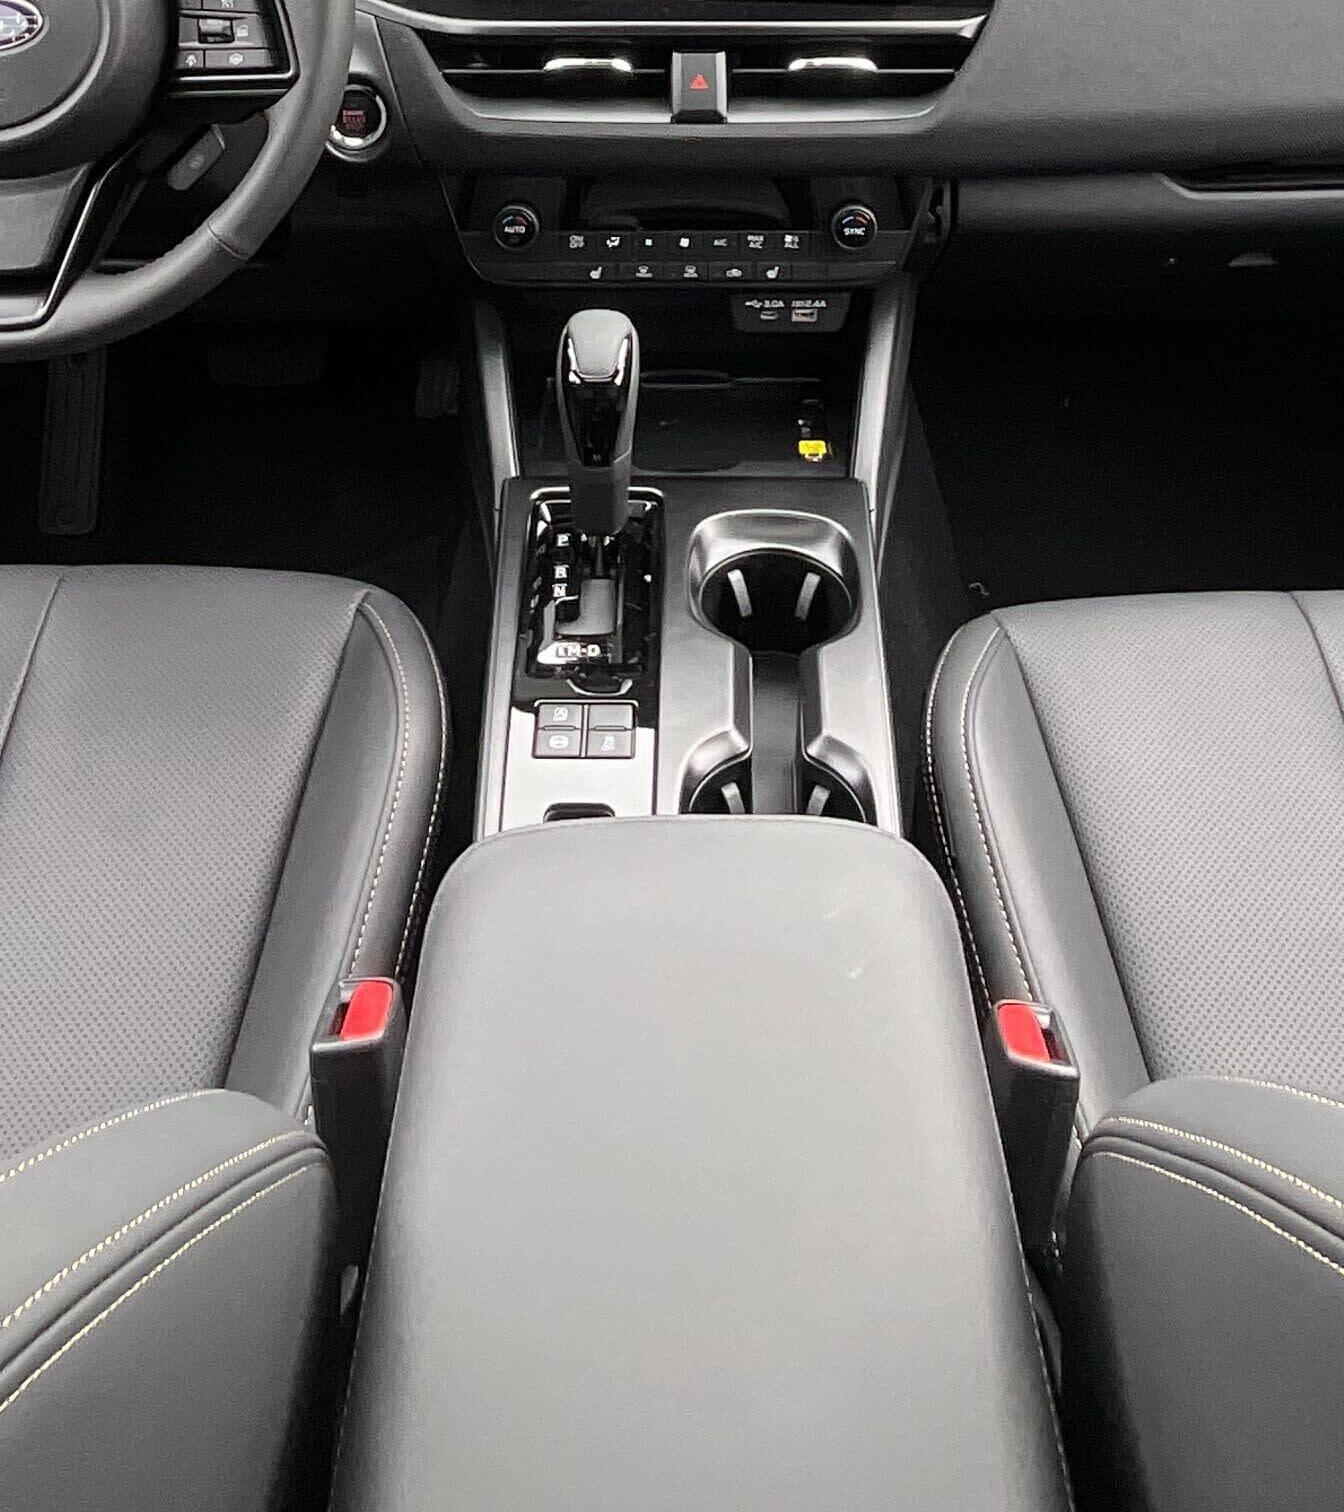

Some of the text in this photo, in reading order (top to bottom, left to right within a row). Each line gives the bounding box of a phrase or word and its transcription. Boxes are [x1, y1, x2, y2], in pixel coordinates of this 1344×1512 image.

[504, 226, 526, 234] AUTO
[843, 227, 866, 236] SYNC
[557, 533, 570, 547] P
[554, 565, 569, 579] R
[552, 584, 568, 598] N
